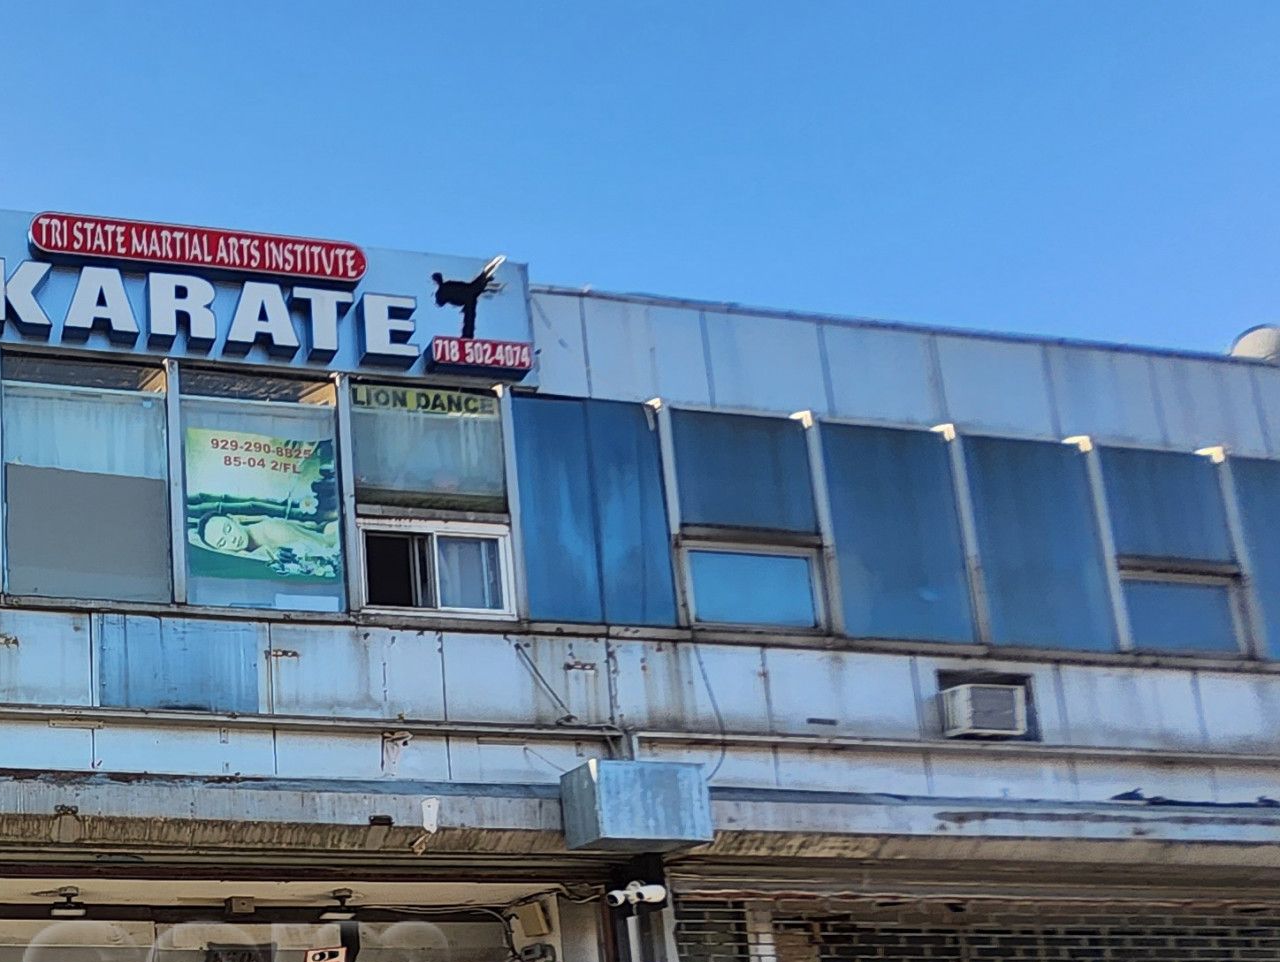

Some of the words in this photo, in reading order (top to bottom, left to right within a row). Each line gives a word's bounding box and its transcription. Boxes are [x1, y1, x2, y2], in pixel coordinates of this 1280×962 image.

[37, 217, 68, 248] TRI
[72, 221, 126, 254] STATE
[130, 226, 212, 263] MARTIAL
[216, 235, 260, 268] ARTS
[264, 240, 358, 277] INSTITUTE
[435, 338, 460, 363] 718
[351, 387, 408, 408] LION
[415, 392, 495, 415] DANCE
[223, 455, 266, 469] 85-04
[271, 460, 301, 474] 2/FL
